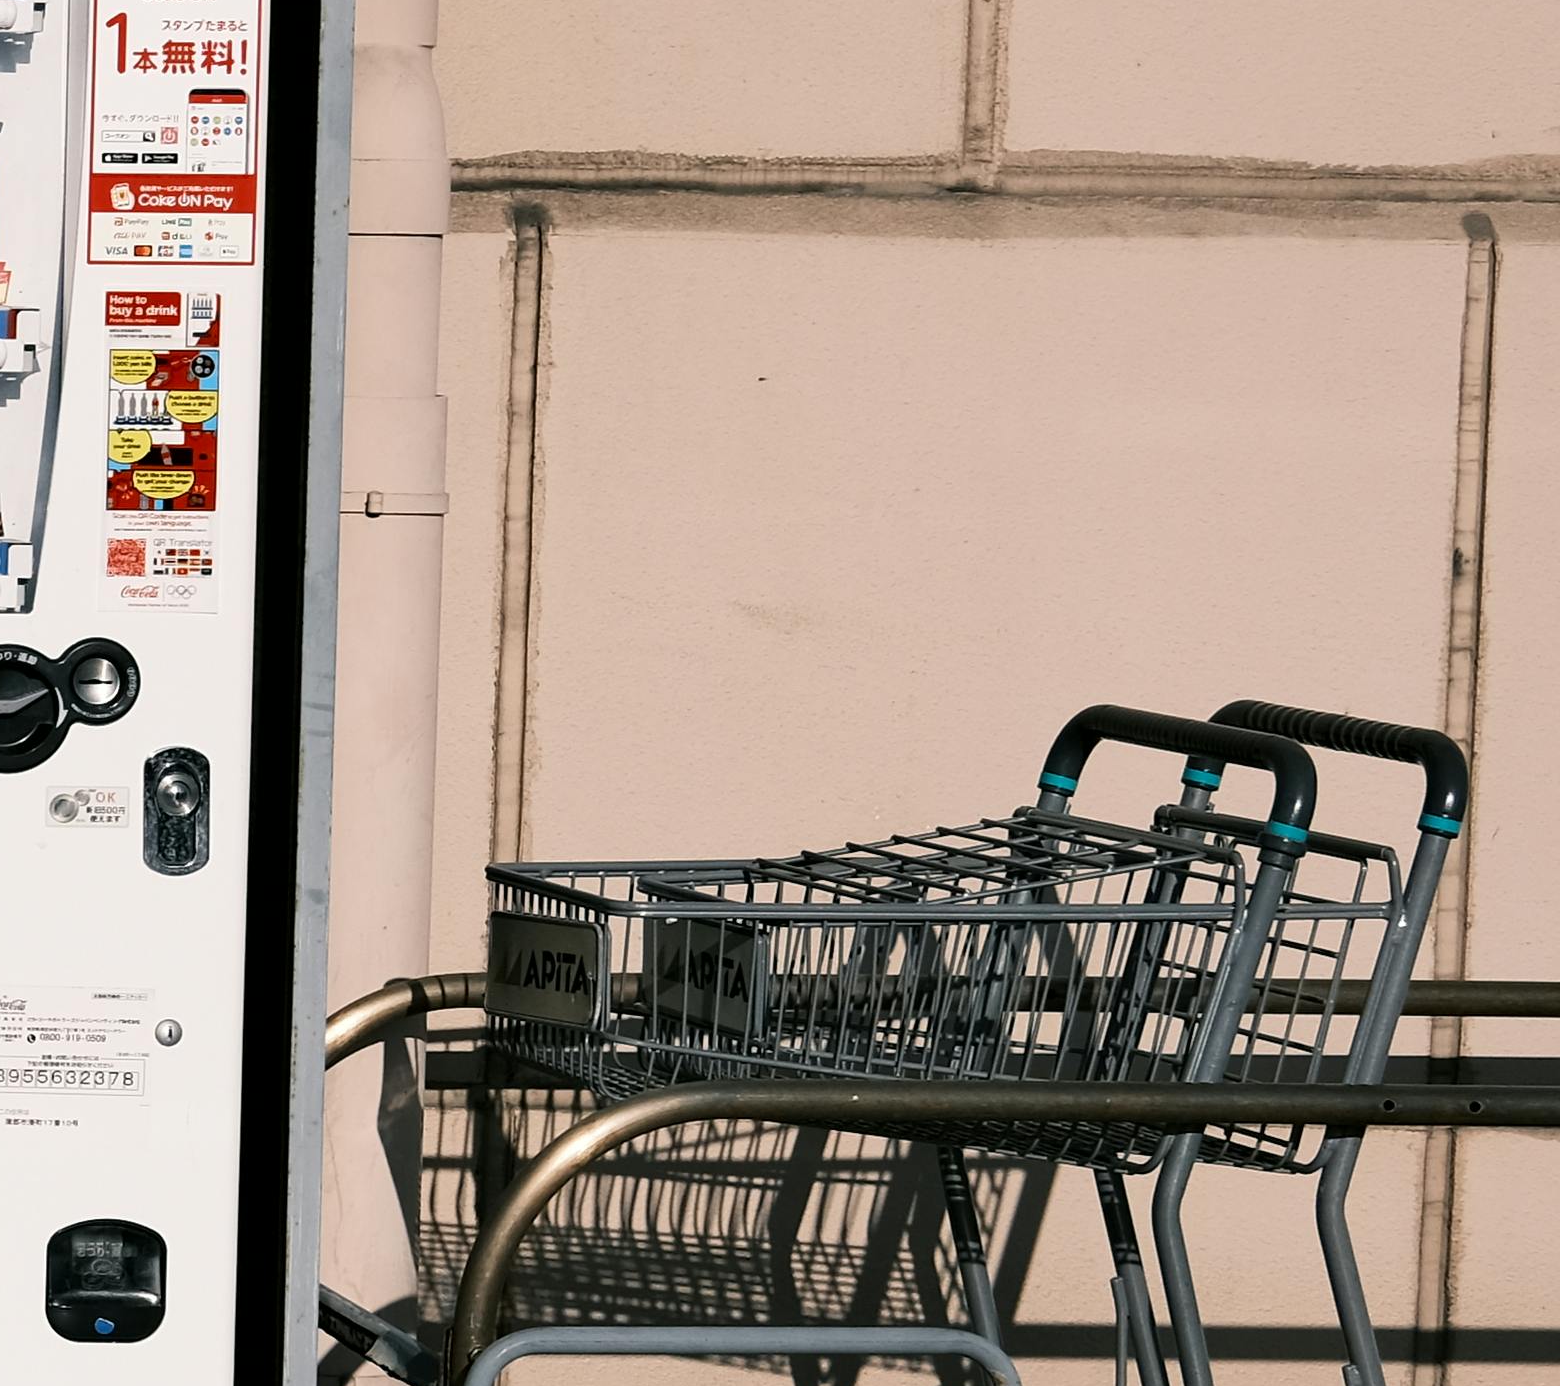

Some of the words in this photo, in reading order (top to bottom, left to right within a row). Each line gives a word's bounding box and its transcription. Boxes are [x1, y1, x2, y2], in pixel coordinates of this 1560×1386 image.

[160, 19, 249, 33] スタンプたまると
[137, 193, 177, 207] Coke
[203, 194, 234, 211] Pay
[105, 246, 129, 256] VISA
[109, 295, 133, 305] How
[135, 295, 148, 305] to
[109, 305, 133, 317] buy
[135, 307, 143, 316] a
[145, 305, 178, 316] drink
[95, 791, 117, 803] OK
